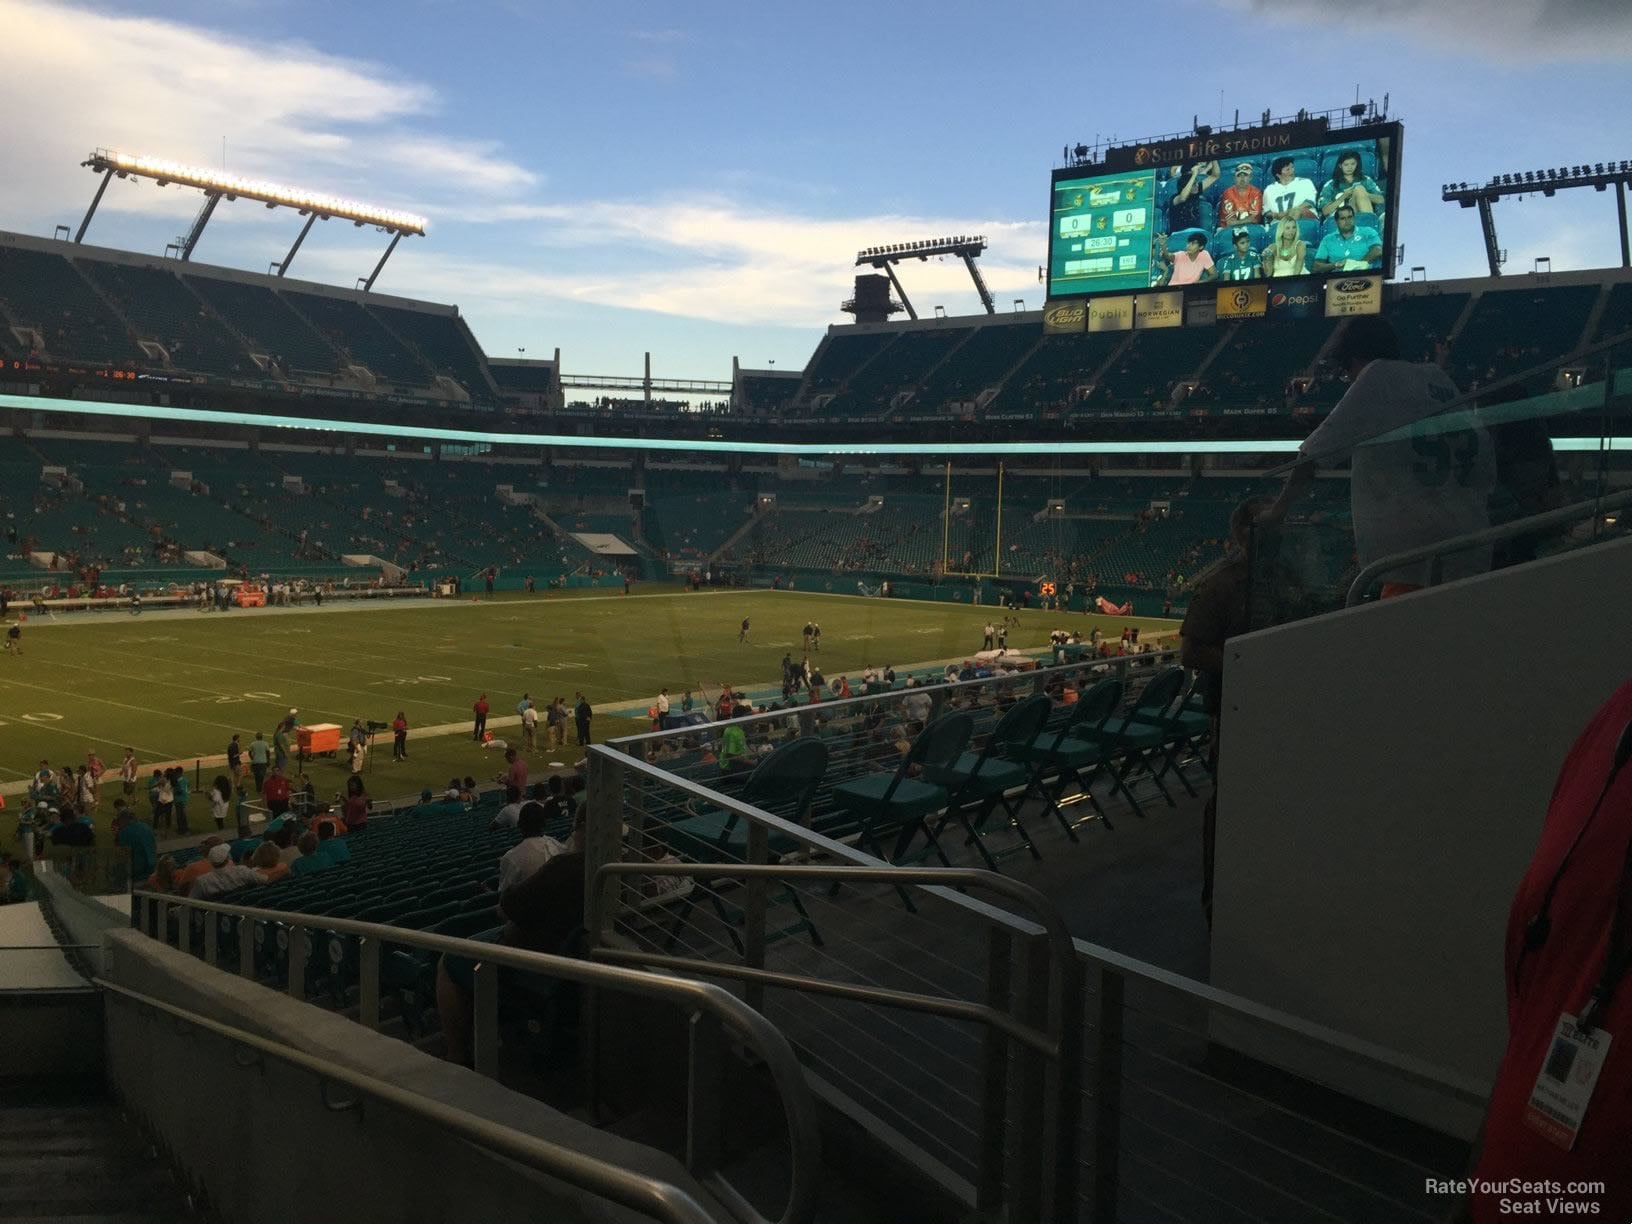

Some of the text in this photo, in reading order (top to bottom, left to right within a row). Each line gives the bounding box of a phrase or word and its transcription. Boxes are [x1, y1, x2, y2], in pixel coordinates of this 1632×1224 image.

[1152, 134, 1291, 163] Sun Life STADIUM
[1275, 192, 1297, 213] 17
[1341, 279, 1366, 291] Ford
[1288, 293, 1320, 306] pepsi
[1055, 309, 1084, 317] BUD
[1137, 309, 1180, 318] NORWEGIAN
[1050, 315, 1084, 324] LIGHT
[1041, 583, 1055, 595] 25
